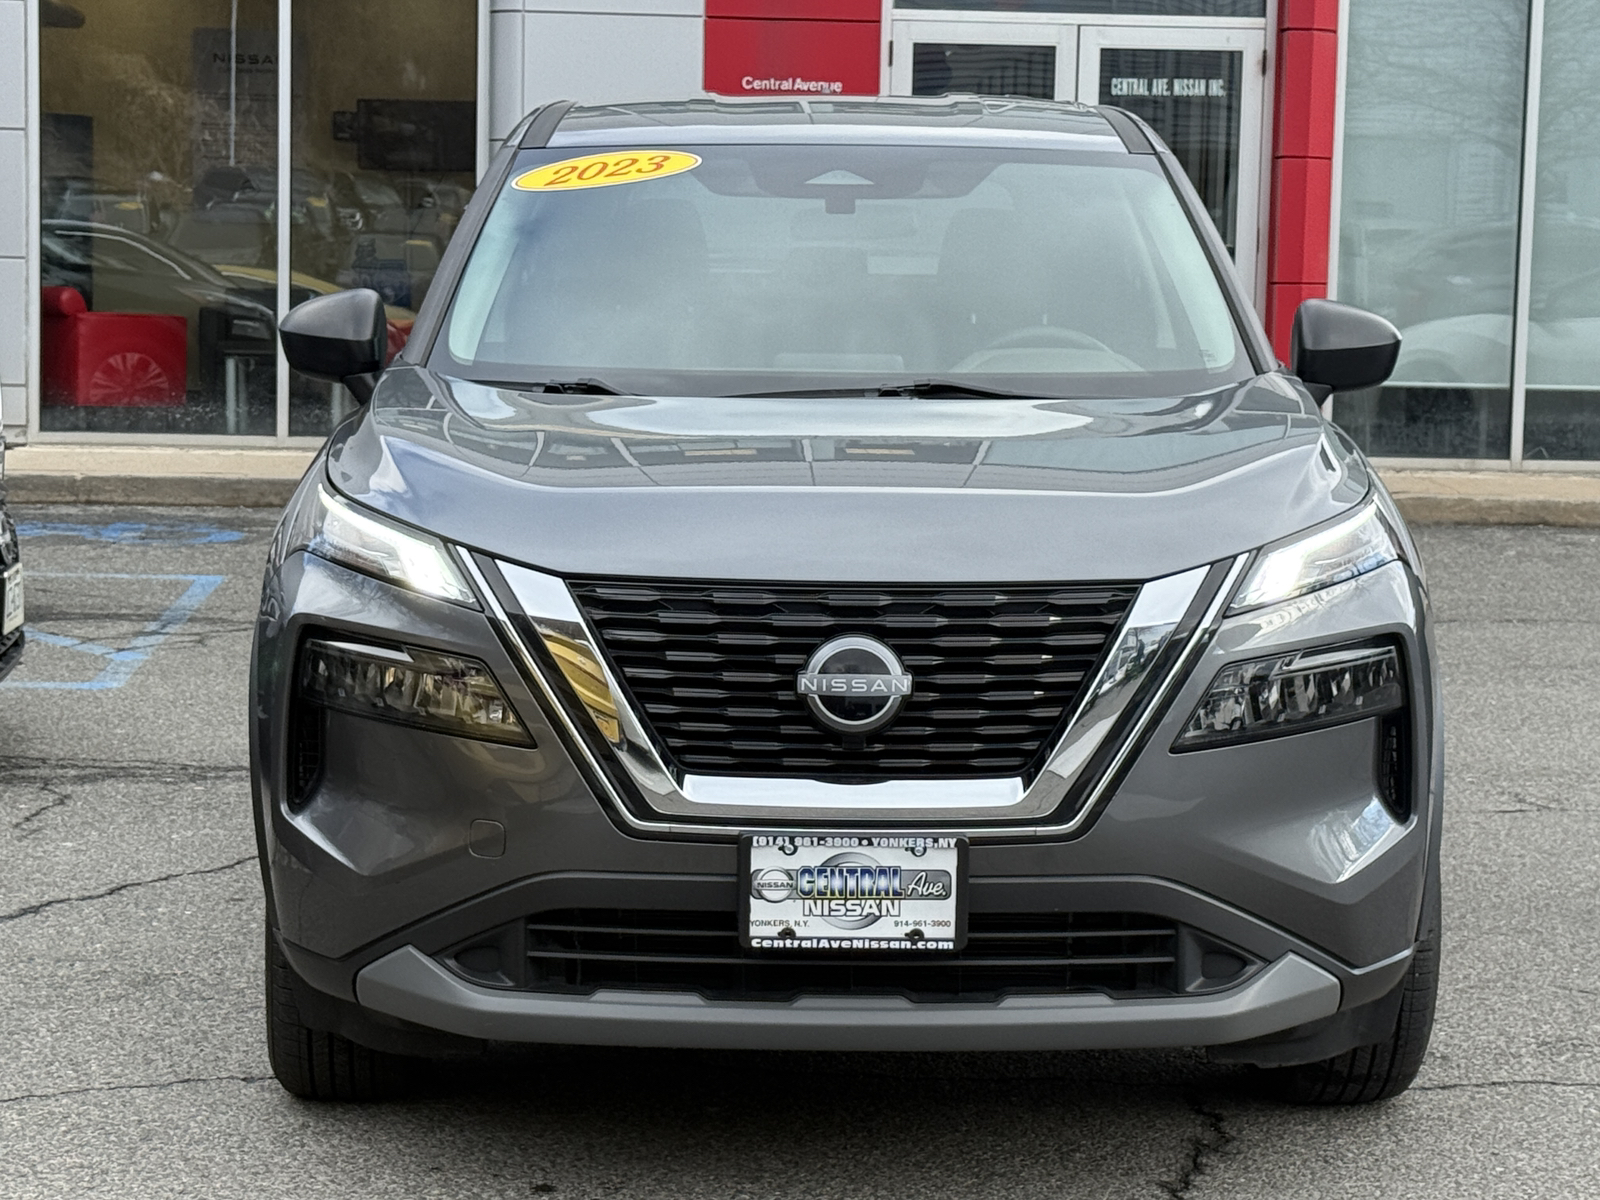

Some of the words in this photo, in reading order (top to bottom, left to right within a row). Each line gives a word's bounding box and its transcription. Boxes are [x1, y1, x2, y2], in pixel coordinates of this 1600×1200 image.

[213, 53, 279, 65] NISSA
[741, 76, 792, 90] Central
[793, 78, 843, 93] Avenue
[1110, 78, 1149, 96] CENTRAL
[1173, 78, 1206, 97] NISSAN
[543, 155, 671, 187] 2023
[801, 678, 908, 692] NISSAN
[797, 866, 906, 899] CENTRAL
[907, 870, 947, 897] Ave.
[803, 899, 901, 917] NISSAN
[750, 919, 792, 928] YONKERS,
[794, 920, 811, 928] N.Y.
[894, 919, 951, 928] 914-961-3900
[751, 938, 954, 949] CentralAveNissan.com
